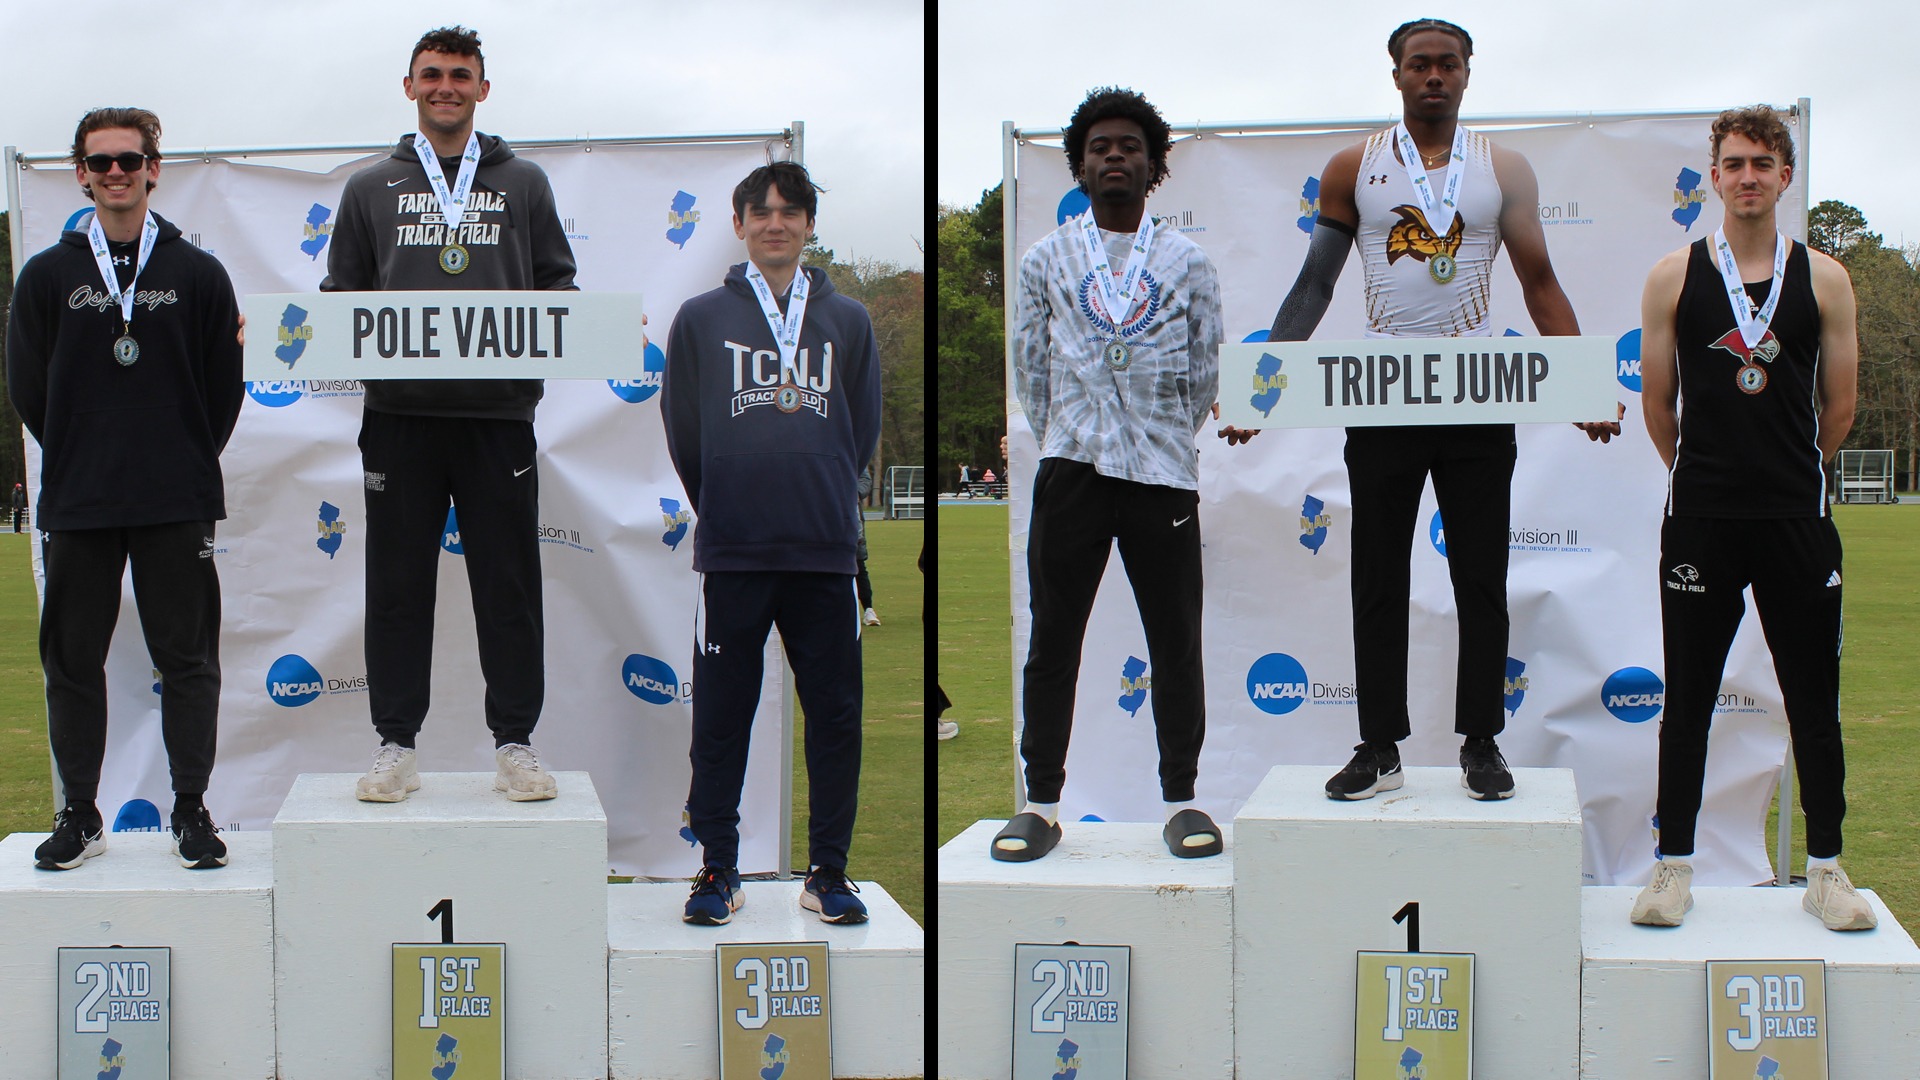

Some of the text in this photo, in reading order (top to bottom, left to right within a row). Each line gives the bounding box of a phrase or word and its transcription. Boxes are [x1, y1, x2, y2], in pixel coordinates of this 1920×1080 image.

[397, 192, 506, 214] FARMDALE
[1673, 189, 1707, 210] NJAC
[668, 210, 700, 229] NJAC
[304, 223, 335, 241] NJAC
[396, 224, 444, 246] TRACK
[458, 223, 501, 245] FIELD
[68, 284, 178, 313] Ospeys
[277, 324, 313, 347] NJAC
[353, 306, 569, 359] POLE VAULT
[724, 340, 833, 393] TCNJ
[250, 380, 304, 394] NCAA
[1252, 374, 1288, 396] NJAC
[1317, 352, 1549, 407] TRIPLE JUMP
[317, 520, 347, 540] NJAC
[662, 509, 692, 533] NJAC
[1299, 513, 1332, 535] NJAC
[1508, 527, 1561, 545] ivision
[1560, 546, 1592, 554] DEDICATE
[1666, 580, 1682, 591] TRACK
[1688, 585, 1706, 593] FIELD
[272, 681, 322, 697] NCAA
[628, 672, 676, 698] NCAA
[1120, 677, 1152, 696] NJAC
[1253, 682, 1308, 699] NCAA
[1608, 693, 1664, 707] NCAA
[427, 899, 453, 943] 1
[1392, 902, 1420, 952] 1
[75, 962, 151, 1034] 2ND
[419, 957, 480, 1028] 1ST
[735, 957, 810, 1031] 3RD
[1031, 960, 1109, 1034] 2ND
[1383, 966, 1449, 1041] 1ST
[109, 1001, 159, 1022] PLACE
[440, 997, 491, 1017] PLACE
[770, 996, 821, 1017] PLACE
[1066, 1001, 1118, 1022] PLACE
[1725, 974, 1805, 1052] 3RD
[1405, 1008, 1459, 1031] PLACE
[1763, 1016, 1818, 1038] PLACE
